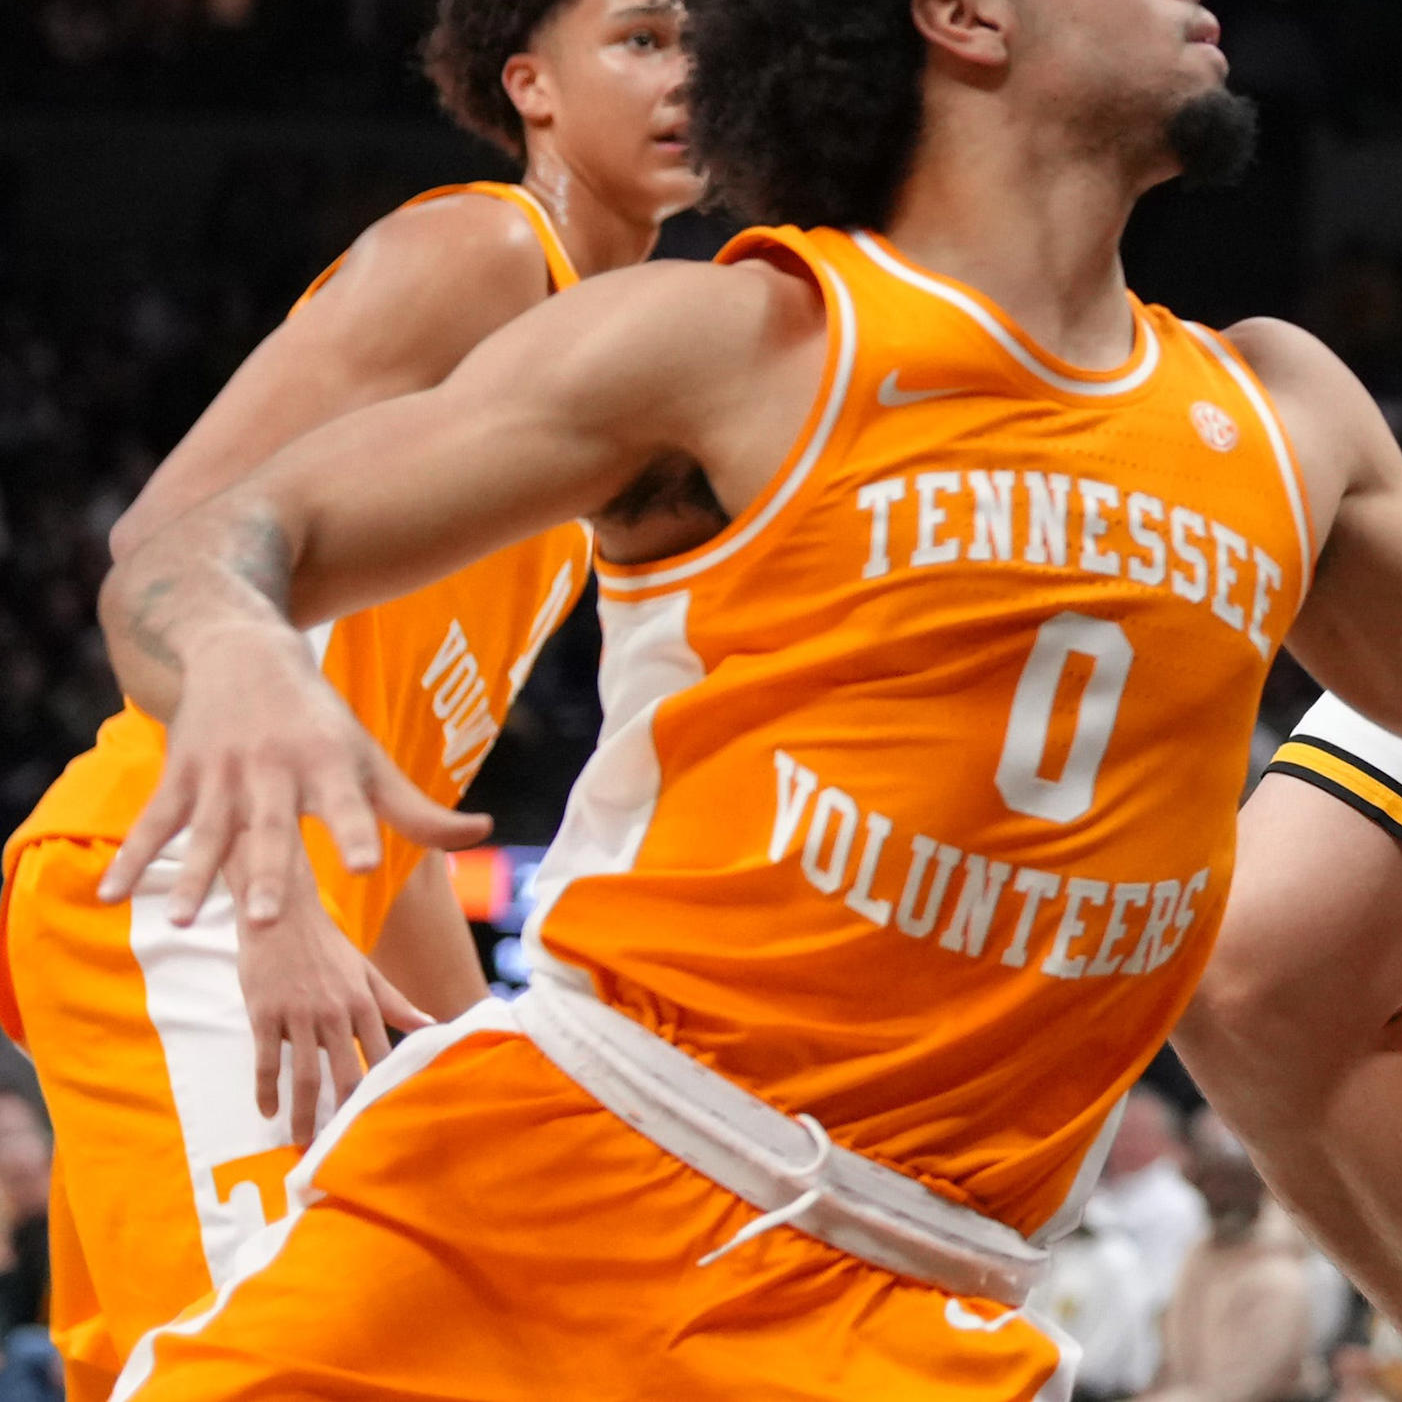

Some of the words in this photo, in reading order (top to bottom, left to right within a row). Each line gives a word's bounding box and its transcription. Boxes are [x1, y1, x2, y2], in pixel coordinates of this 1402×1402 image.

[857, 469, 1282, 661] TENNESSEE
[994, 610, 1134, 825] 0
[769, 748, 1211, 980] VOLUNTEERS
